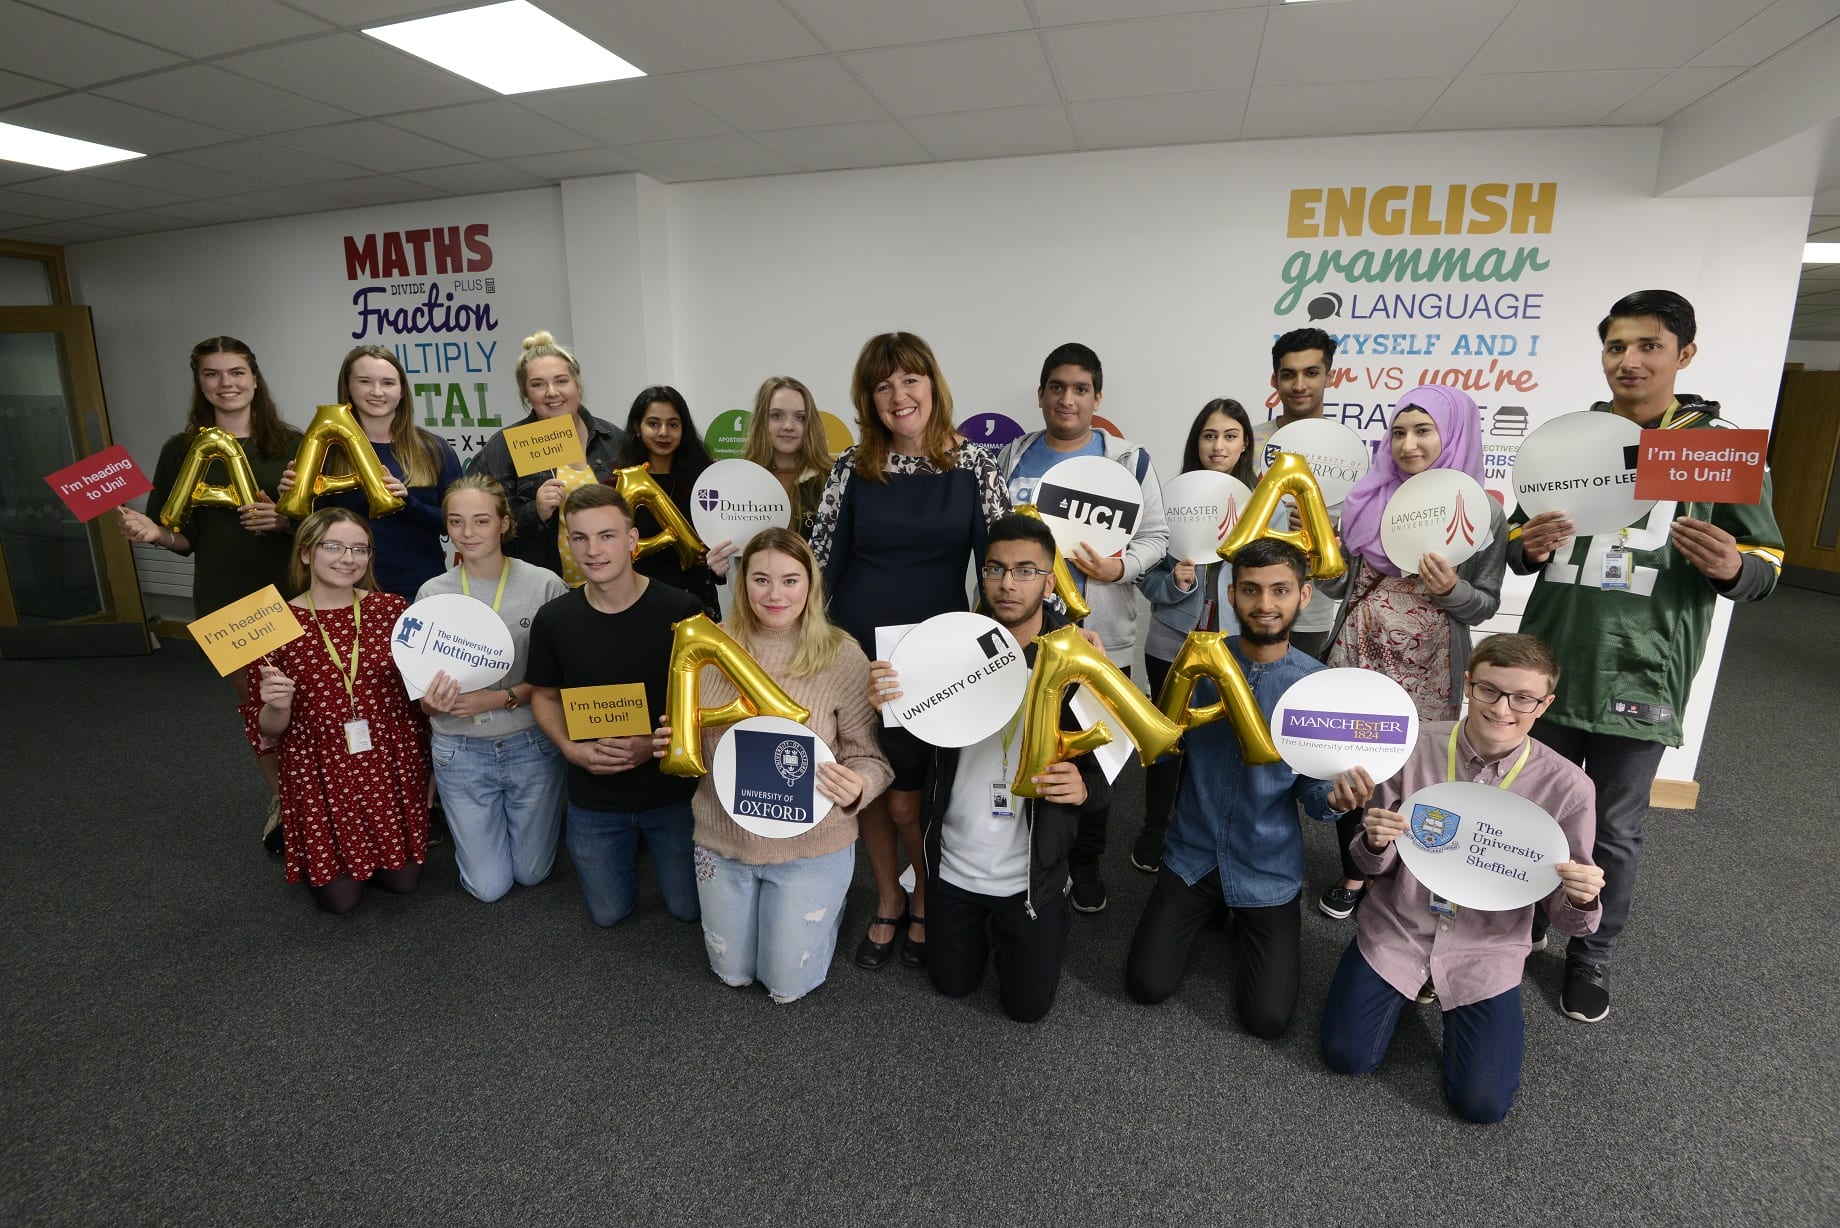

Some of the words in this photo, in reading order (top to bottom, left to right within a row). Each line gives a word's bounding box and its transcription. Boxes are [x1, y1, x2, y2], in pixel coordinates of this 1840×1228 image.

[1286, 182, 1558, 239] ENGLISH
[343, 223, 493, 281] MATHS
[390, 283, 426, 296] DIVIDE
[454, 279, 483, 292] PLUS
[1273, 246, 1550, 316] grammar
[352, 282, 499, 339] Fraction
[1350, 293, 1544, 320] LANGUAGE
[1330, 333, 1441, 356] MYSELF
[1451, 334, 1518, 357] AND
[1527, 334, 1540, 357] I
[394, 341, 498, 374] LTIPLY
[1365, 366, 1404, 390] VS
[413, 382, 503, 428] TAL
[512, 439, 530, 450] I'm
[530, 429, 573, 446] heading
[1483, 444, 1520, 453] ECTIVES
[530, 450, 541, 459] to
[542, 444, 564, 456] Uni!
[1647, 447, 1676, 461] I'm
[1681, 447, 1760, 466] heading
[60, 481, 84, 495] I'm
[81, 458, 133, 485] heading
[1519, 478, 1589, 494] UNIVERSITY
[1592, 476, 1611, 487] OF
[1615, 472, 1637, 485] LEE
[1669, 467, 1688, 481] to
[1694, 467, 1732, 482] Uni!
[86, 489, 102, 500] to
[100, 476, 127, 493] Uni!
[719, 499, 784, 512] Durham
[1067, 499, 1127, 533] UCL
[1166, 505, 1219, 516] ANCASTER
[1391, 505, 1447, 525] LANCASTER
[720, 512, 773, 523] University
[1167, 515, 1219, 523] NIVERSITY
[1391, 518, 1447, 532] UNIVERSITY
[203, 629, 229, 645] I'm
[228, 601, 284, 632] heading
[231, 638, 247, 650] to
[247, 621, 277, 641] Uni!
[437, 629, 452, 641] The
[452, 635, 492, 655] University
[432, 639, 510, 670] Nottingham
[902, 679, 966, 720] UNIVERSITY
[967, 670, 985, 685] OF
[982, 651, 1017, 676] LEEDS
[569, 701, 590, 711] I'm
[593, 697, 643, 709] heading
[588, 715, 602, 724] to
[604, 711, 629, 723] Uni!
[1289, 715, 1404, 733] MANCHESTER
[1353, 730, 1379, 740] 1824
[1280, 738, 1297, 746] The
[1298, 740, 1342, 752] University
[1344, 744, 1354, 752] of
[1354, 744, 1406, 754] Manchester
[741, 788, 782, 801] UNIVERSITY
[784, 794, 794, 803] OF
[739, 799, 807, 821] OXFORD
[1476, 820, 1503, 837] The
[1469, 843, 1487, 857] Of
[1472, 832, 1545, 863] University
[1465, 855, 1529, 883] Sheffield.
